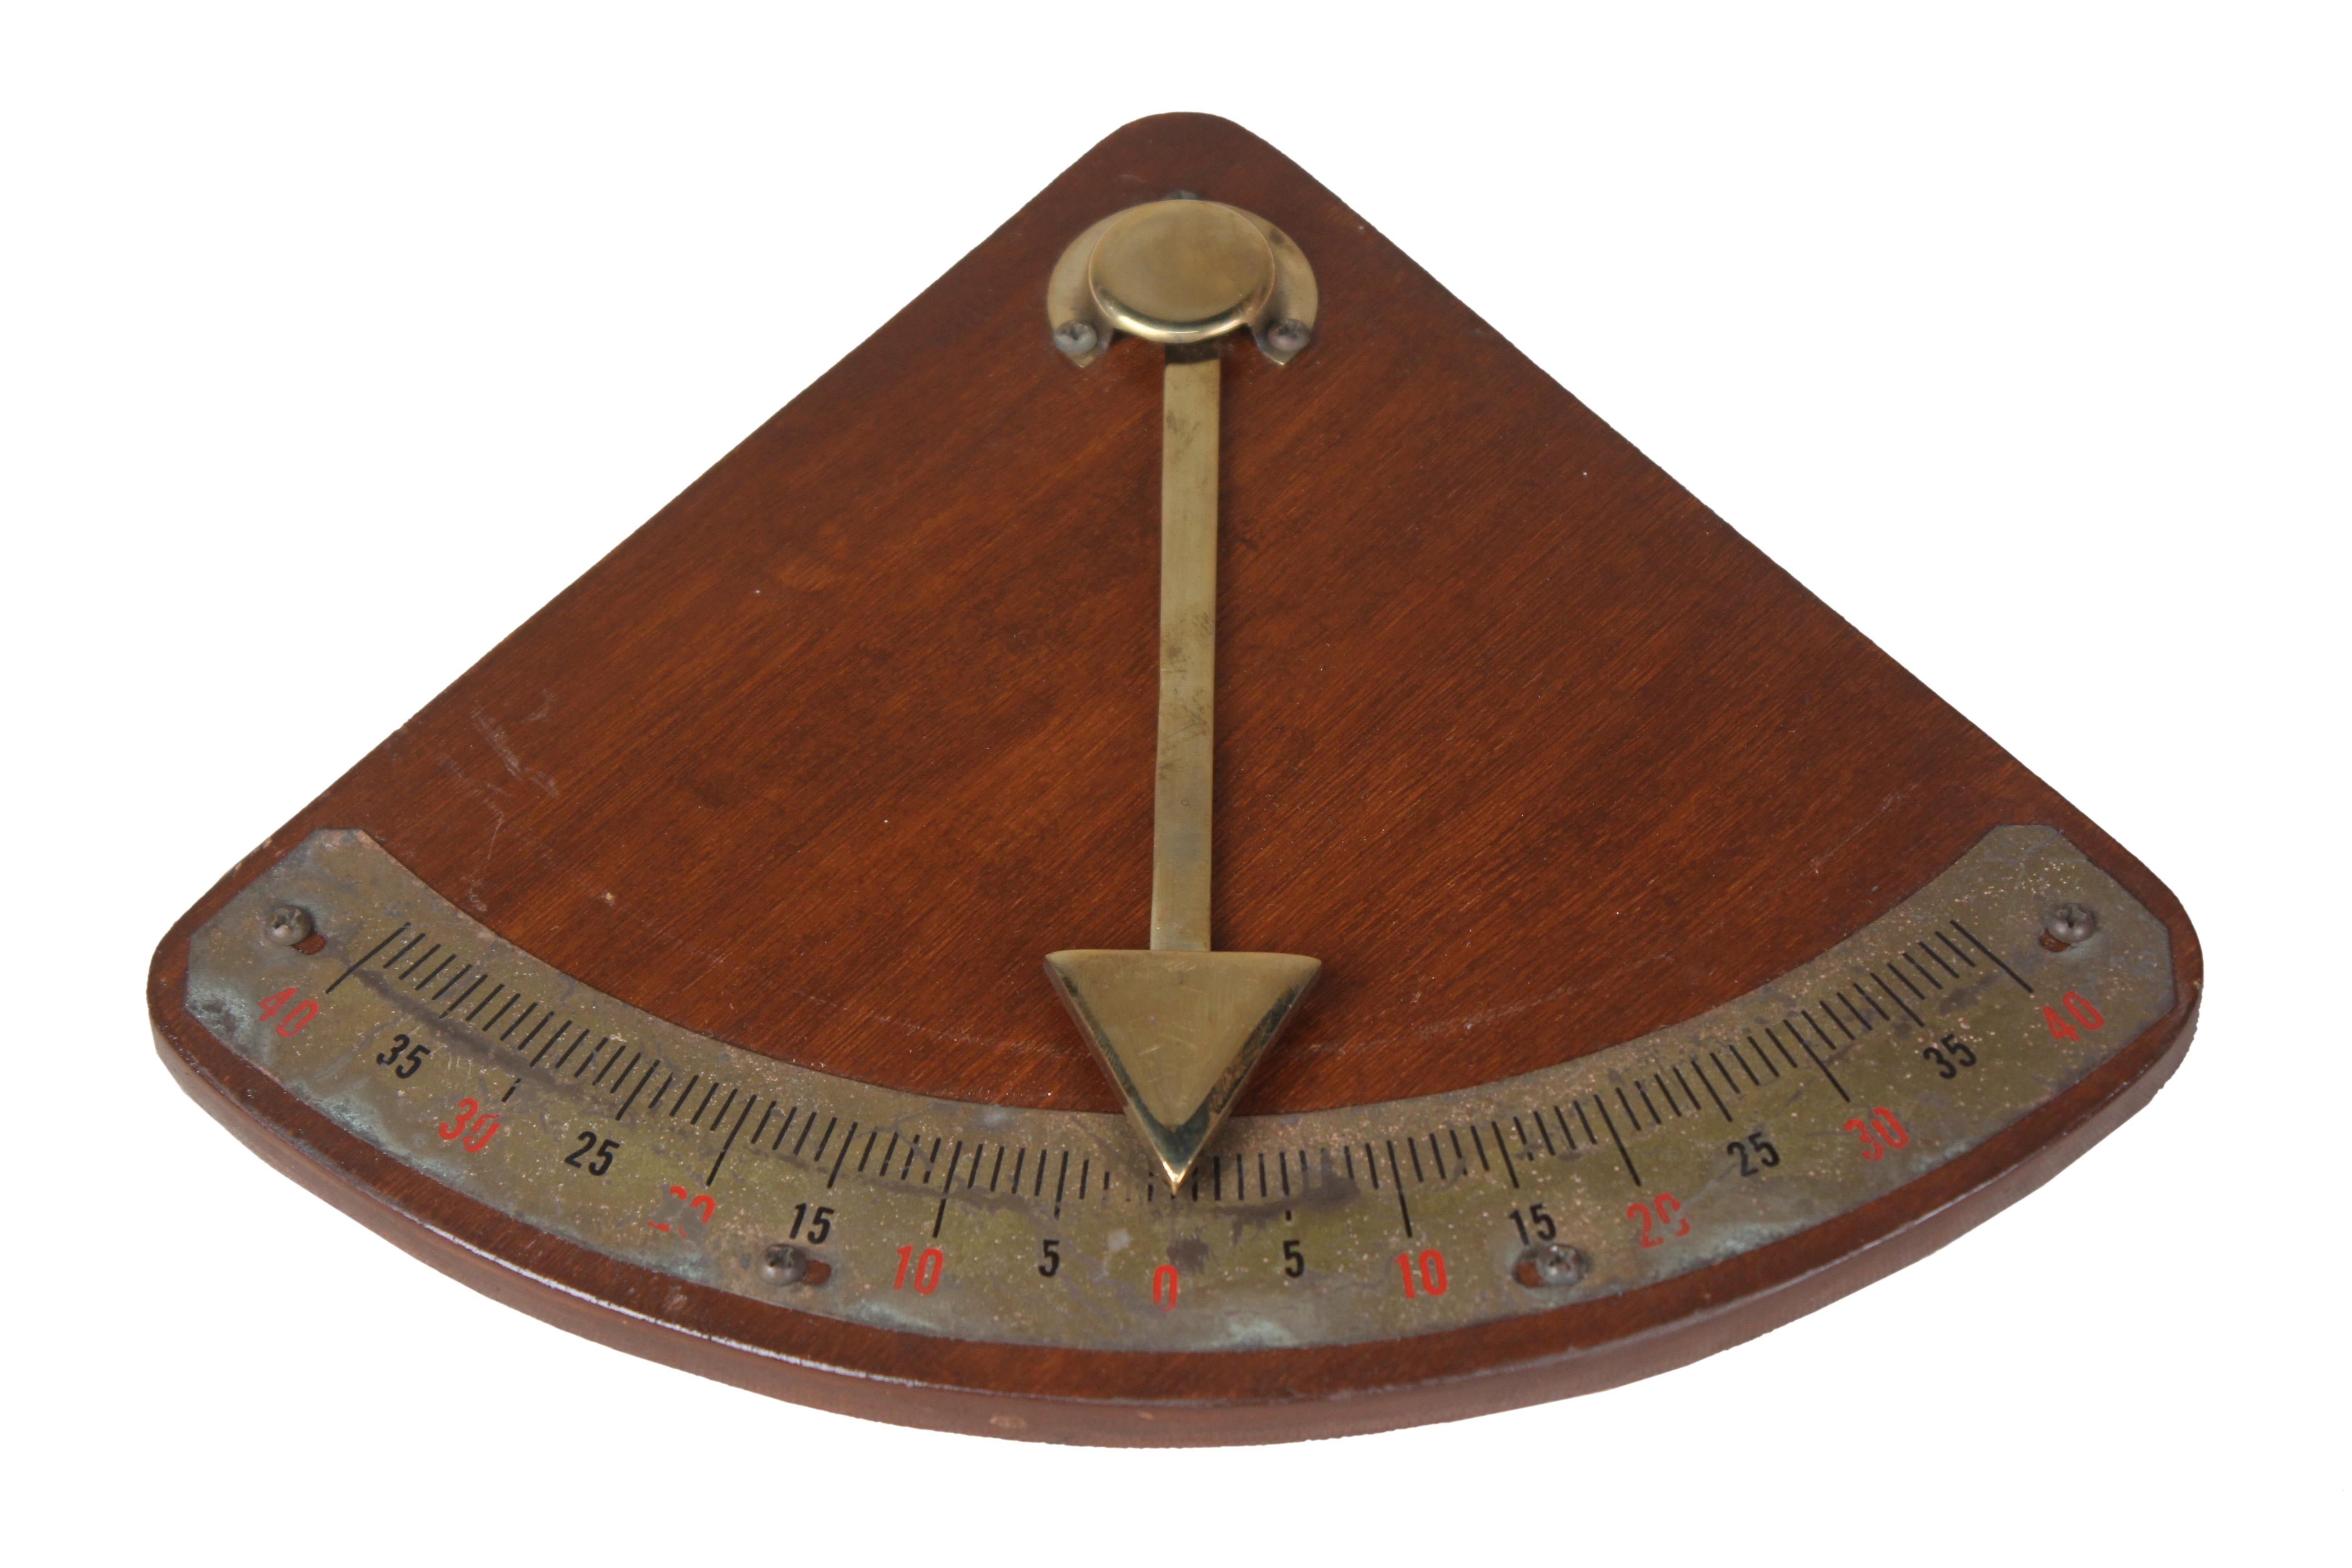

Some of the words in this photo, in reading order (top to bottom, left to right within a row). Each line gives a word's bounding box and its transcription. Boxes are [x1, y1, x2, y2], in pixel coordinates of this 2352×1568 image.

[258, 987, 318, 1037] 40
[2043, 992, 2104, 1042] 40
[377, 1034, 430, 1079] 35
[1923, 1034, 1977, 1079] 35
[439, 1098, 500, 1152] 30
[1844, 1107, 1909, 1160] 30
[564, 1131, 620, 1176] 25
[1727, 1132, 1780, 1177] 25
[790, 1203, 834, 1244] 15
[1509, 1203, 1557, 1245] 15
[1627, 1192, 1690, 1249] 20
[894, 1245, 943, 1295] 10
[1039, 1240, 1060, 1277] 5
[1284, 1240, 1304, 1278] 5
[1394, 1249, 1448, 1298] 10
[1153, 1264, 1179, 1312] 0
